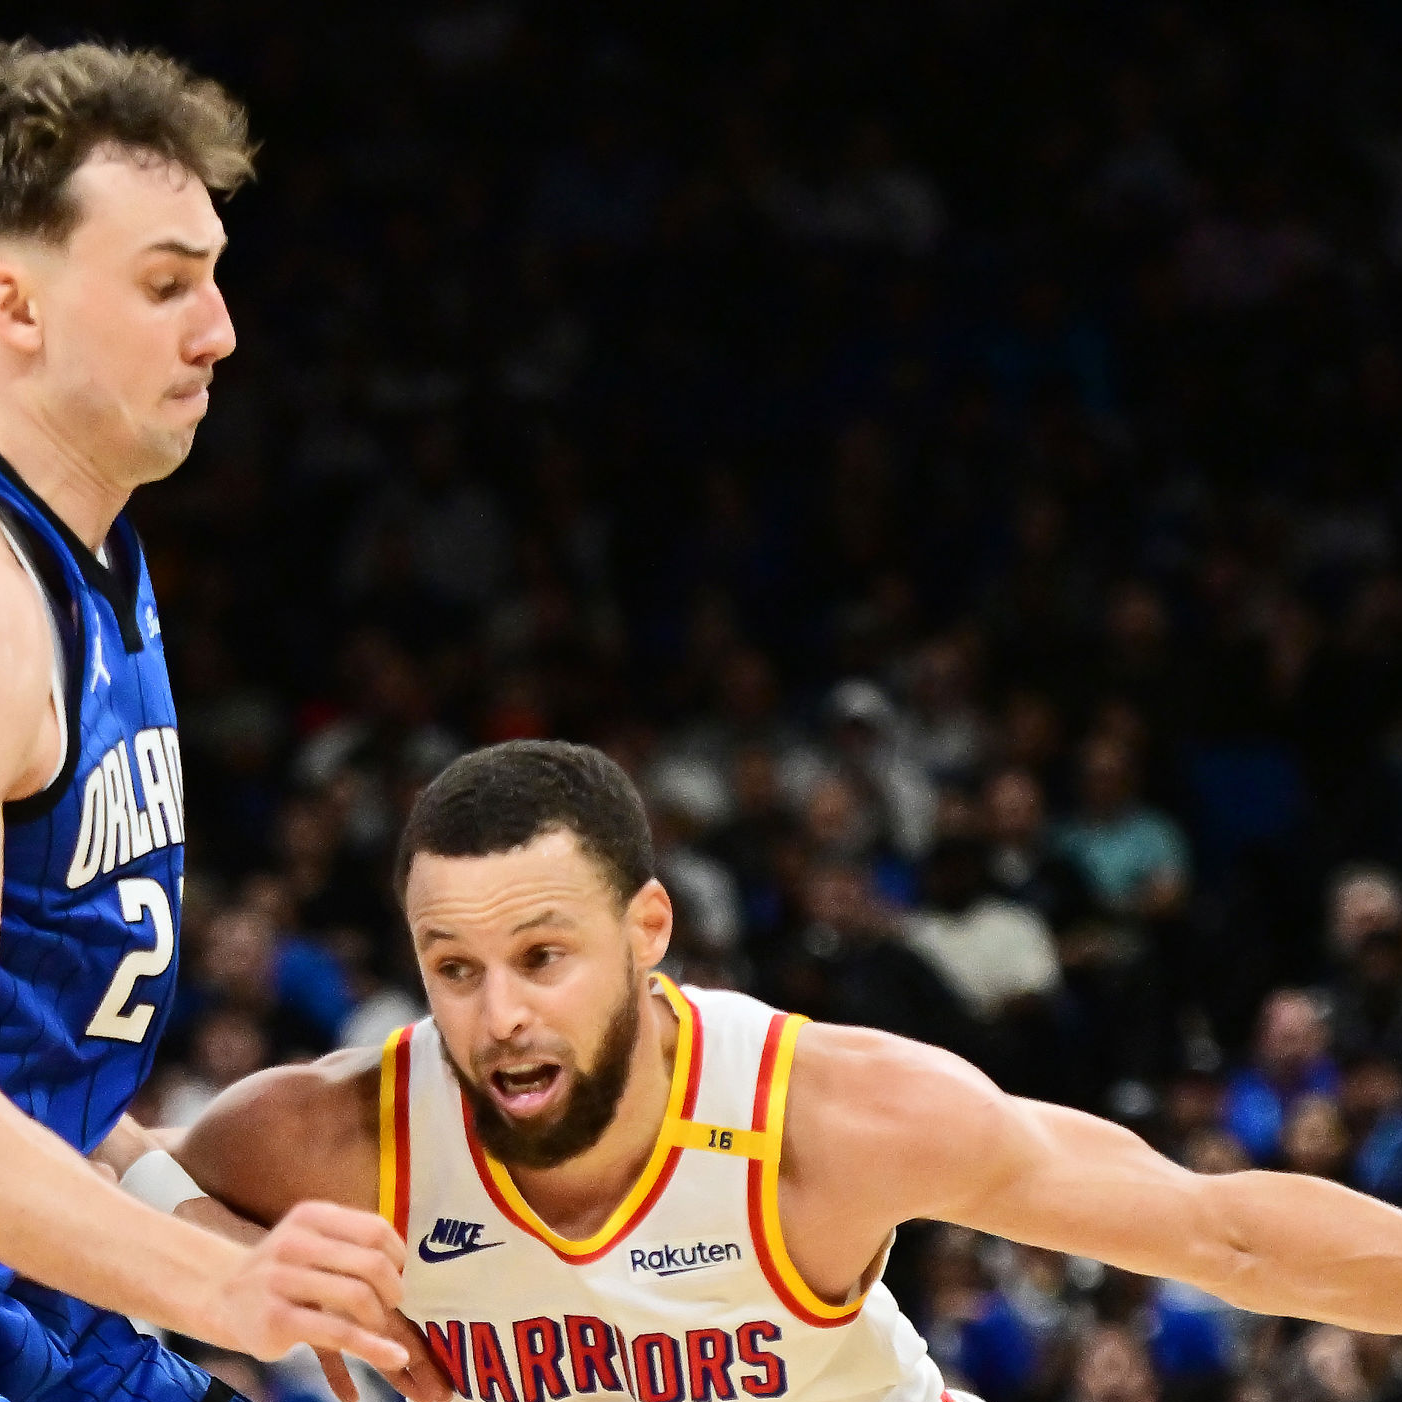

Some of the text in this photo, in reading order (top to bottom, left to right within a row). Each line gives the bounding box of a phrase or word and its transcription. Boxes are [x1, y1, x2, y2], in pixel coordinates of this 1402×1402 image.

[85, 876, 185, 1044] 2
[708, 1129, 734, 1150] 16
[429, 1217, 486, 1249] NIKE
[630, 1242, 742, 1272] Rakuten
